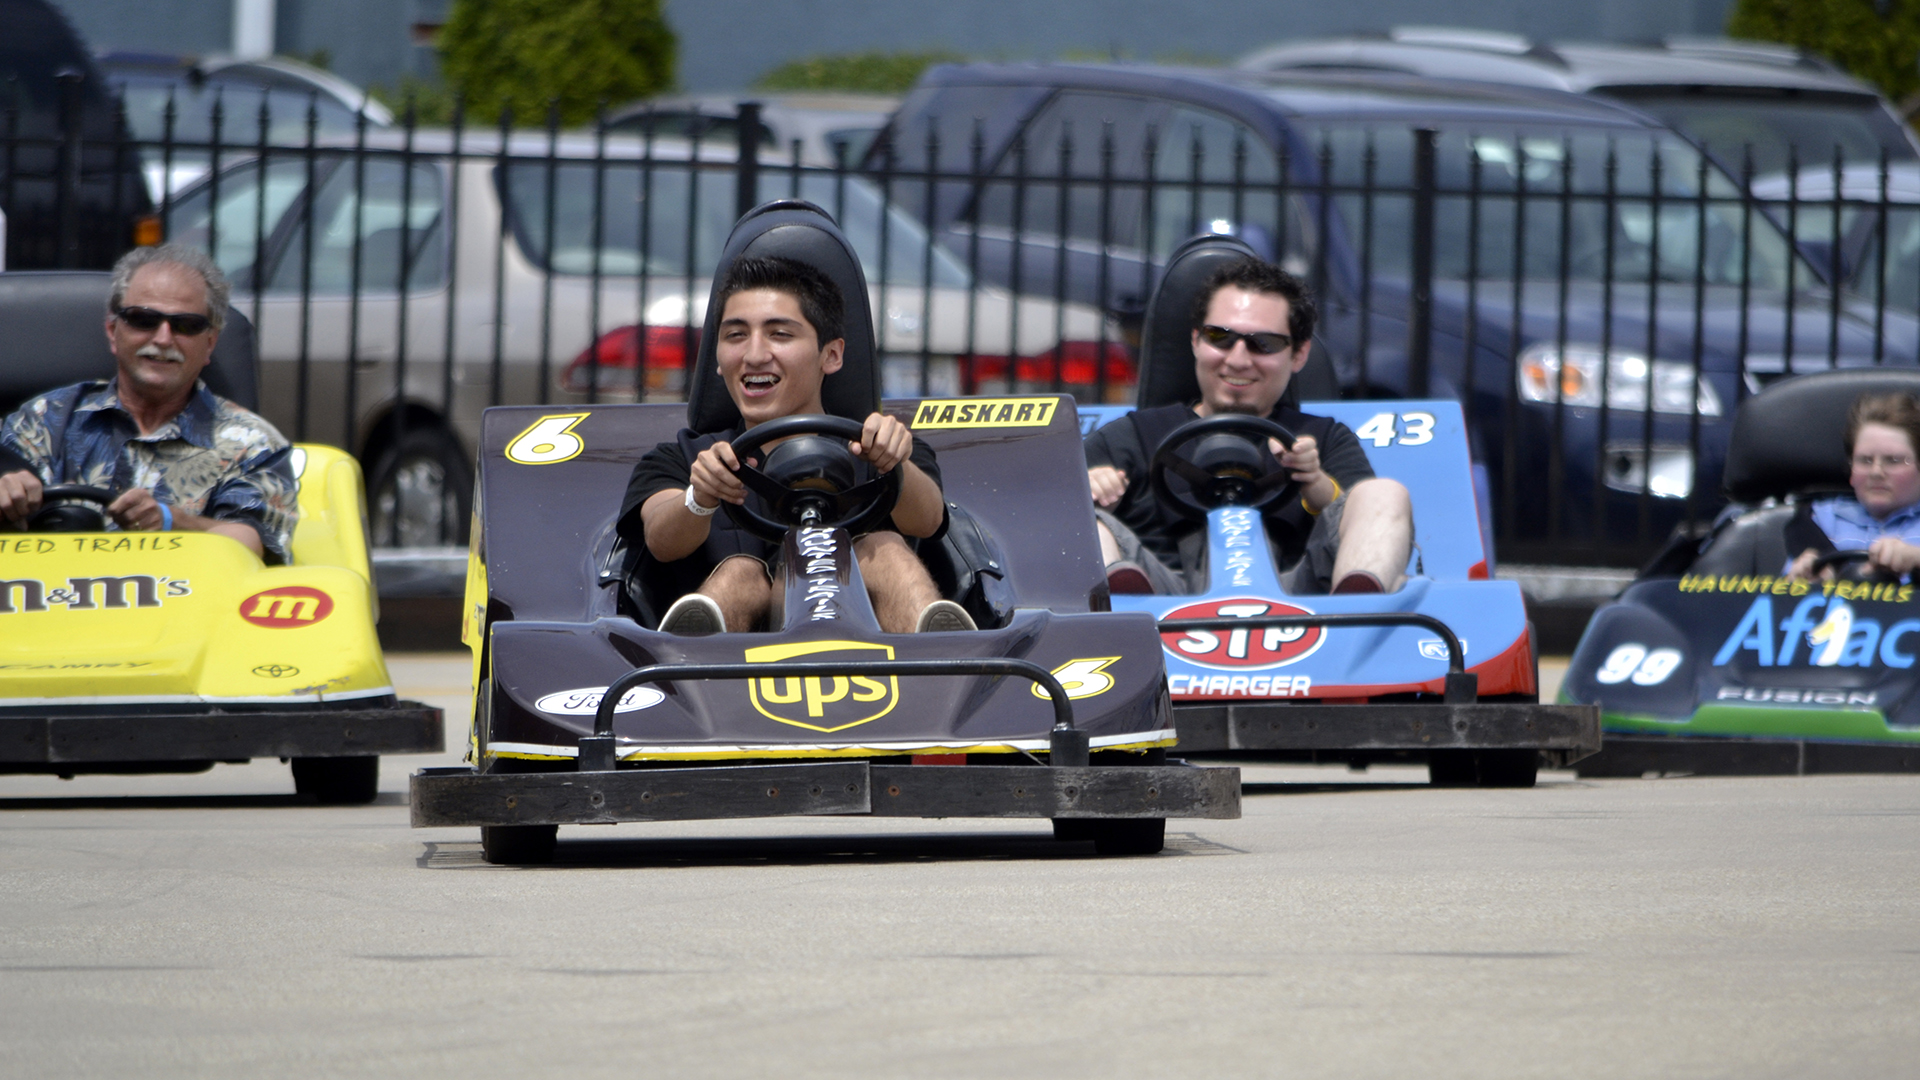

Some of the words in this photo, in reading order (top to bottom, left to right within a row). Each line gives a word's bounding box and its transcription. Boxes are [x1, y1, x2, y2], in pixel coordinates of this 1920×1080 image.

[917, 403, 1053, 424] NASKART
[504, 412, 591, 465] 6
[1355, 412, 1435, 447] 43
[73, 536, 183, 552] TRAILS
[1678, 574, 1810, 596] HAUNTED
[1822, 580, 1914, 602] TRAILS
[1177, 604, 1308, 660] STP
[1031, 656, 1122, 700] 6
[1596, 644, 1682, 685] 99
[564, 693, 635, 709] Fod
[760, 675, 888, 717] ups
[1168, 675, 1311, 697] CHARGER
[1717, 687, 1877, 705] FUSION
